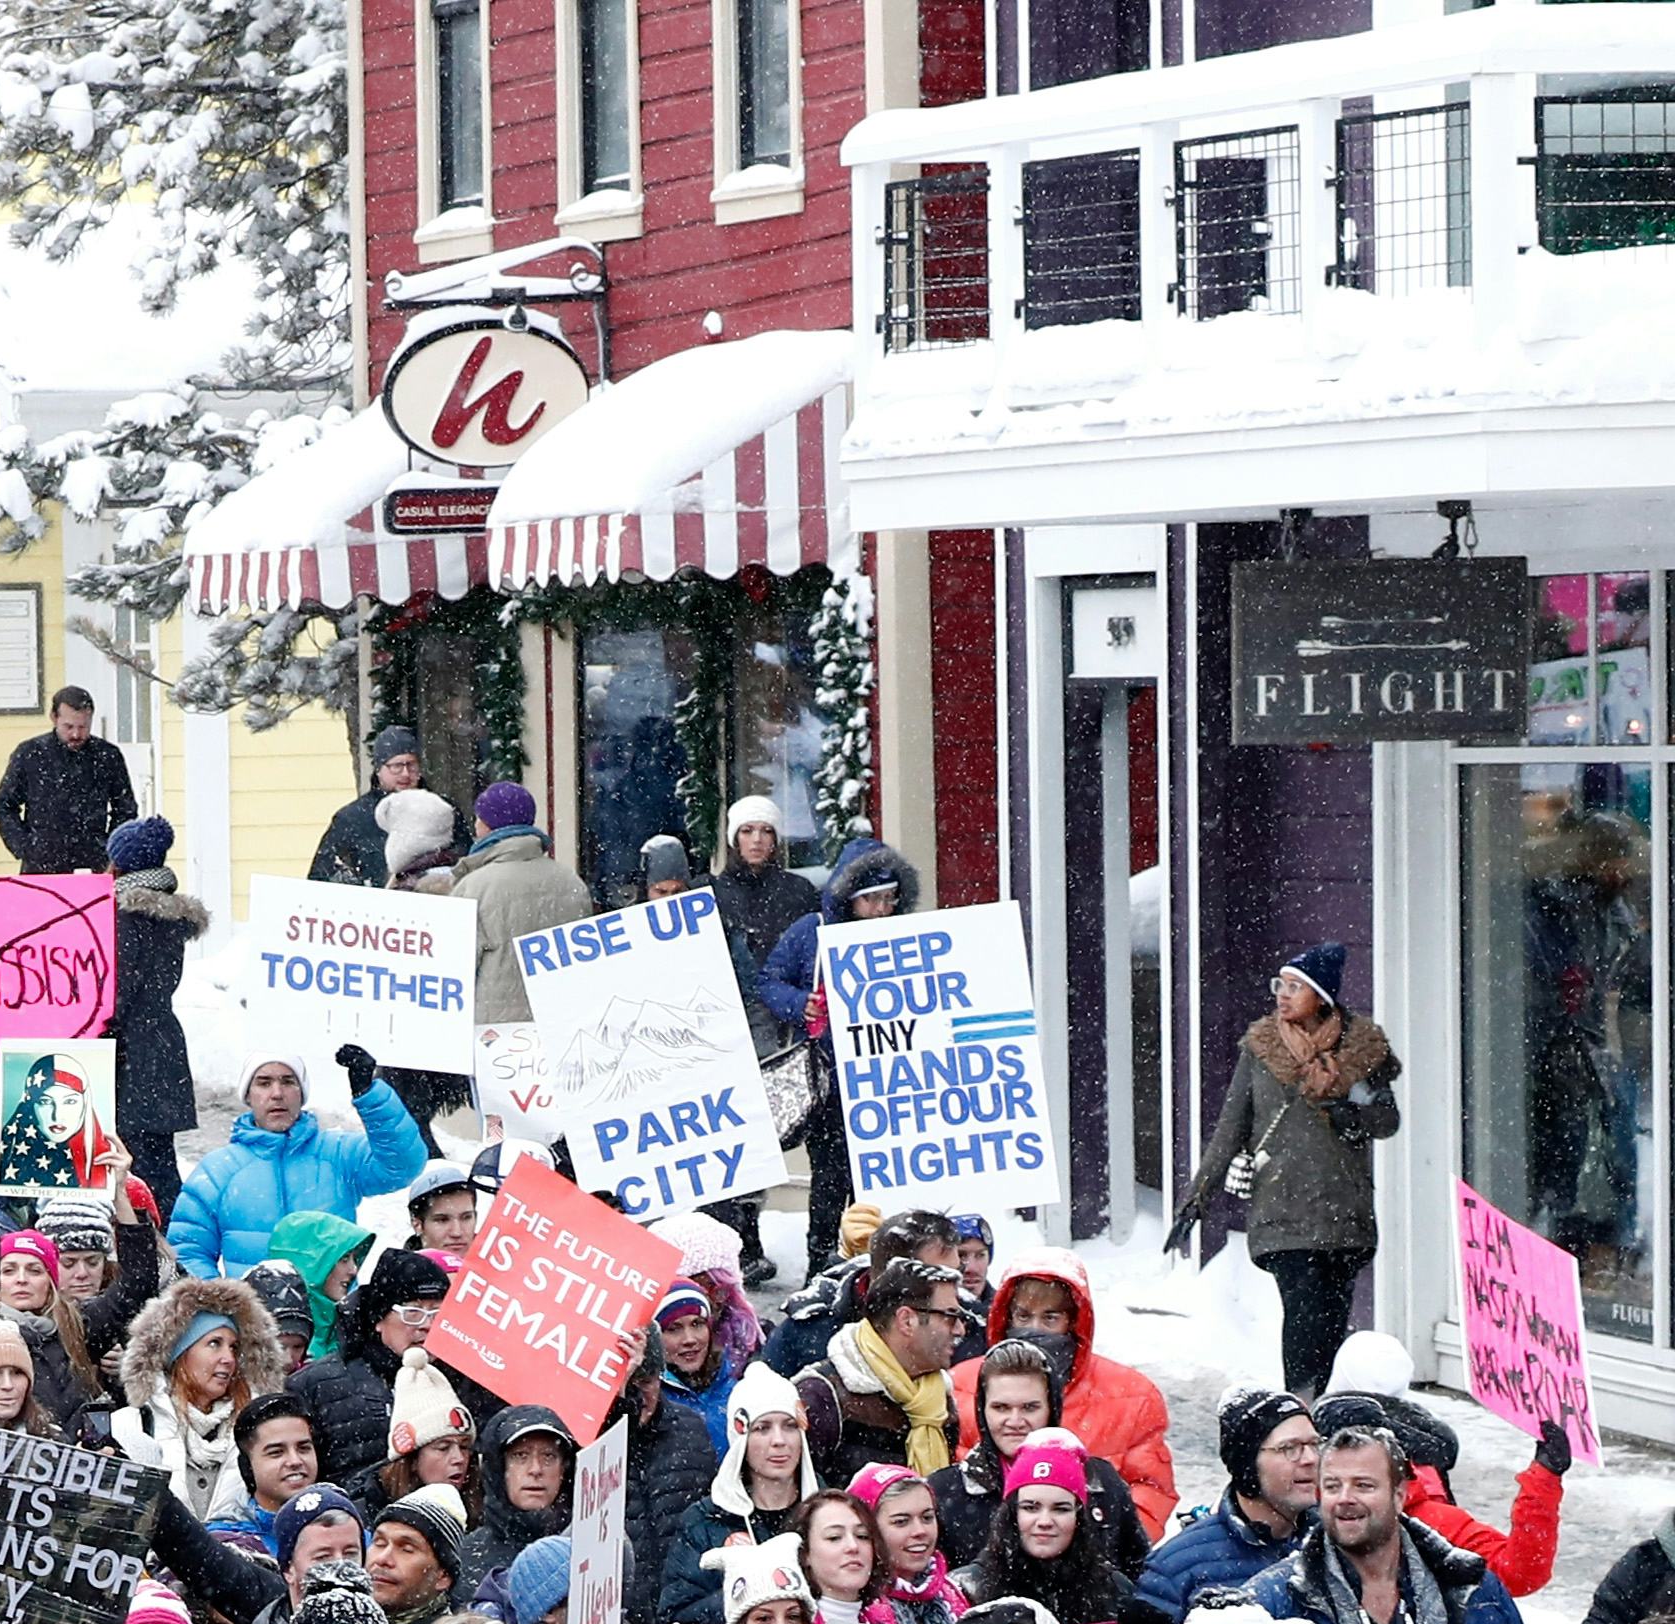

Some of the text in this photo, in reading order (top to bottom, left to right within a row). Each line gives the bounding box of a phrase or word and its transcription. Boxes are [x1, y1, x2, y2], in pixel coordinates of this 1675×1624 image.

[395, 505, 435, 519] CASUAL
[1254, 669, 1517, 717] FLIGHT
[286, 914, 434, 958] STRONGER
[519, 893, 715, 977] RISE UP
[827, 931, 954, 984] KEEP
[261, 952, 464, 1011] TOGETHER
[837, 970, 973, 1023] YOUR
[846, 1018, 917, 1057] TINY
[845, 1044, 1026, 1100] HANDS
[594, 1086, 746, 1162] PARK
[616, 1144, 744, 1216] CITY
[859, 1130, 1044, 1190] RIGHTS
[502, 1193, 660, 1302] THE FUTURE
[479, 1226, 635, 1340] IS STILL
[456, 1270, 623, 1392] FEMALE
[68, 1546, 143, 1596] FOR
